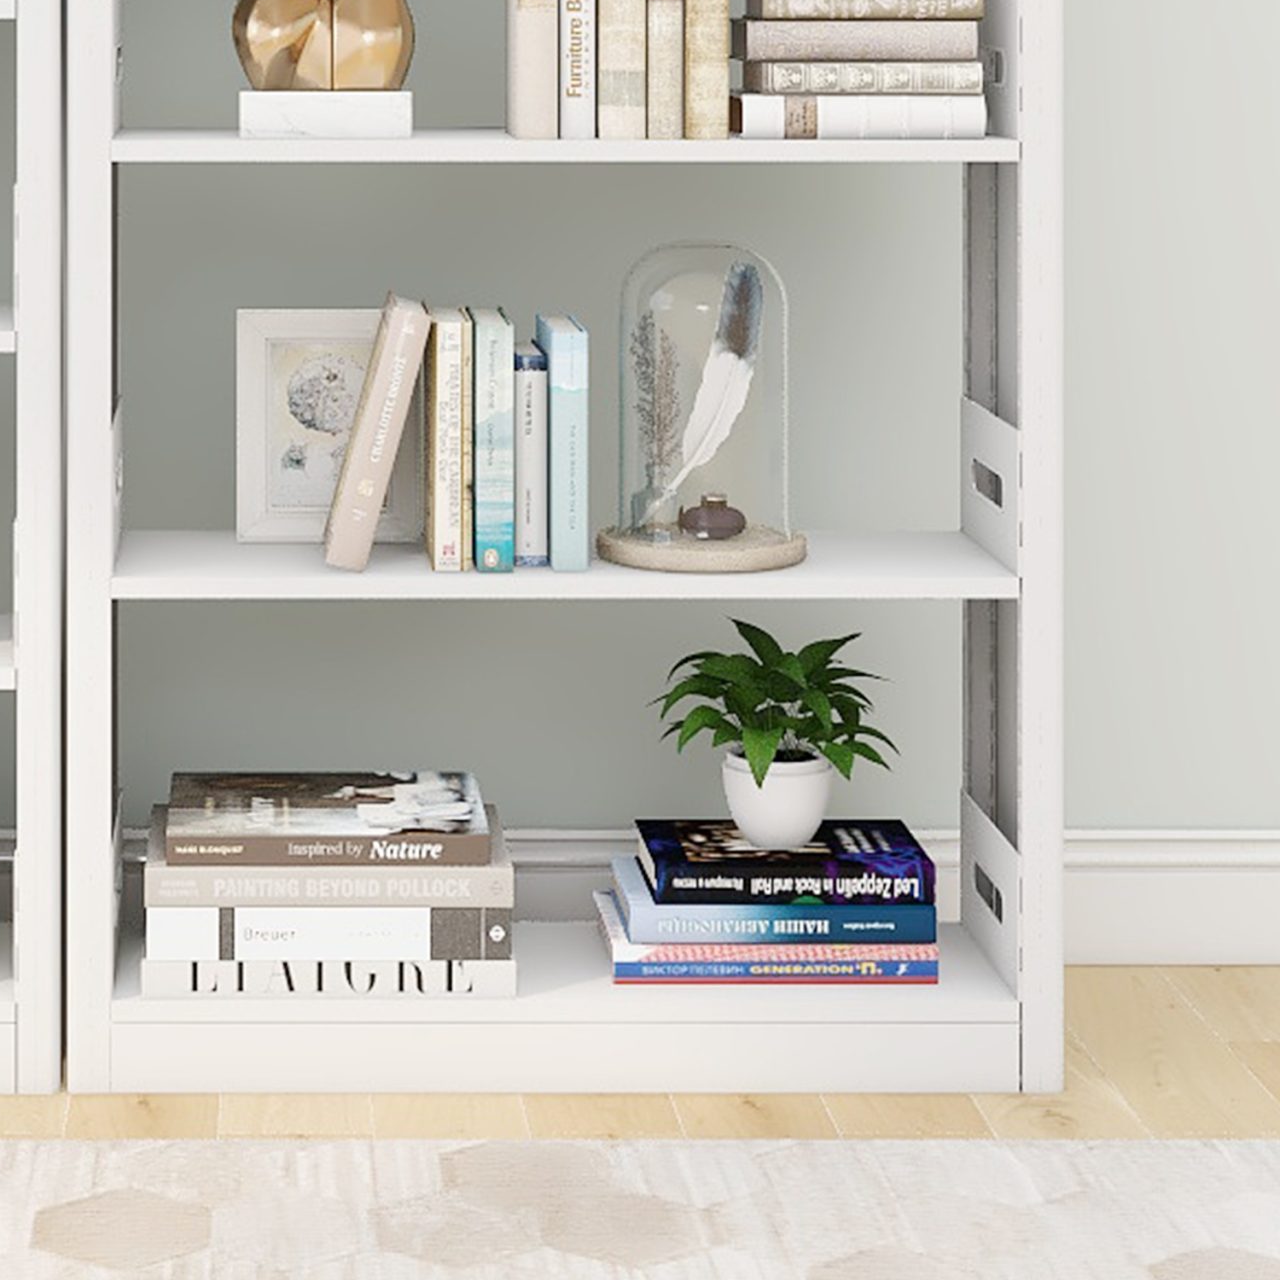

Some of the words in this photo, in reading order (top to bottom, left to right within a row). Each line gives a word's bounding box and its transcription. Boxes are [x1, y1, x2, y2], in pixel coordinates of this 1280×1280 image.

[566, 17, 583, 98] Furniture
[287, 841, 343, 857] Inspired
[346, 841, 365, 856] by
[369, 840, 444, 860] Nature
[213, 879, 301, 898] PAINTING
[306, 879, 381, 898] BEYOND
[387, 879, 471, 898] POLLOCK
[750, 877, 772, 895] Roll
[772, 877, 793, 894] and
[794, 878, 821, 895] Rock
[822, 879, 833, 894] in
[835, 872, 892, 898] Zeppelin
[893, 877, 919, 898] Led
[242, 927, 297, 942] Breuer
[773, 919, 830, 934] НАШИ
[641, 964, 690, 976] ВИКТОР
[690, 964, 745, 976] ПЕЛЕВИН
[749, 964, 854, 976] GENERATION
